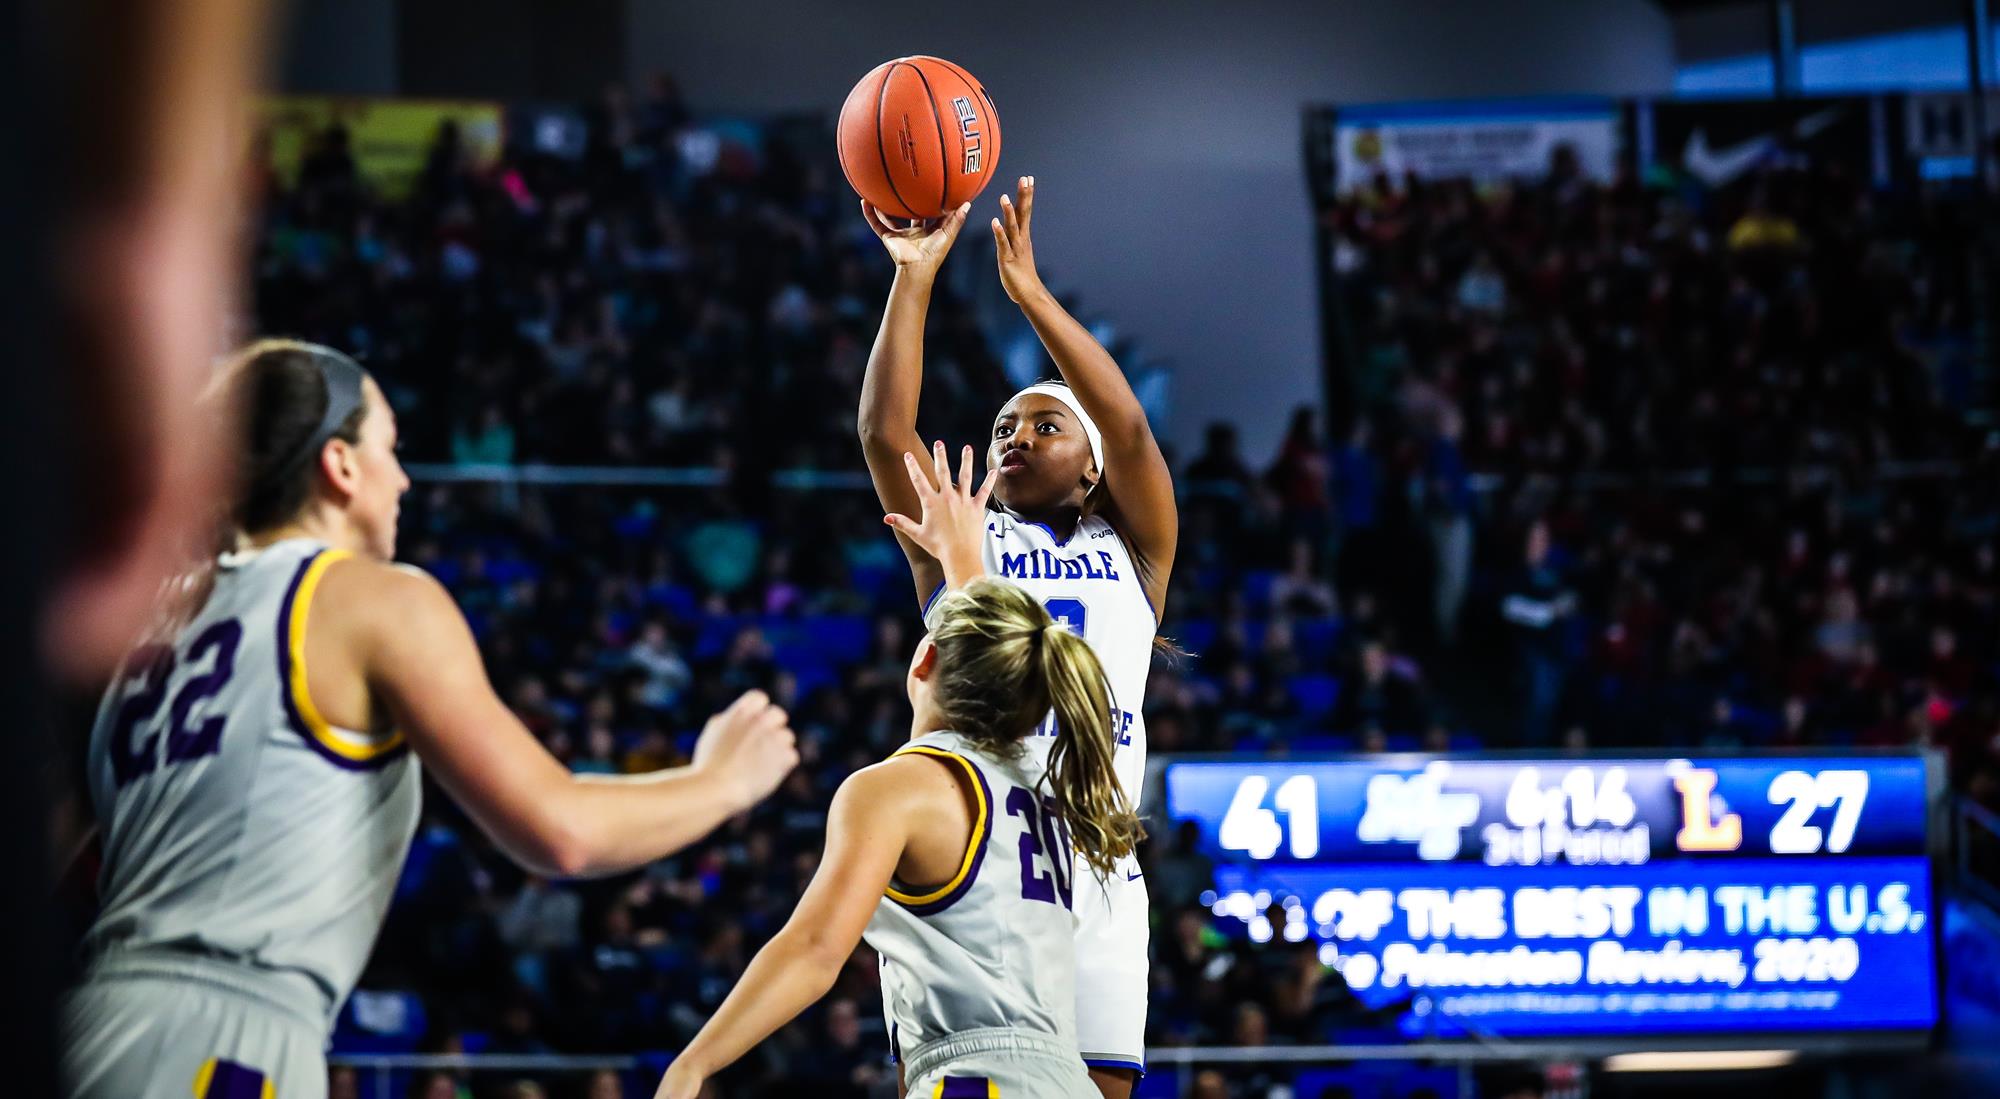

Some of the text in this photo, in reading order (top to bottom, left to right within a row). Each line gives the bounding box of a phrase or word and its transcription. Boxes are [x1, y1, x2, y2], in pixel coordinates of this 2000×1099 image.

[953, 96, 982, 174] ELITE
[1000, 548, 1120, 581] MIDDLE
[108, 617, 242, 791] 22
[1219, 774, 1319, 859] 41
[1673, 768, 1743, 852] L
[1767, 770, 1869, 853] 27
[1314, 888, 1394, 940] OF
[1397, 888, 1507, 940] THE
[1513, 886, 1643, 938] BEST
[1648, 886, 1709, 936] IN
[1713, 884, 1820, 936] THE
[1827, 882, 1926, 934] U.S.
[1381, 942, 1583, 987] Princeton
[1753, 936, 1860, 982] 2020
